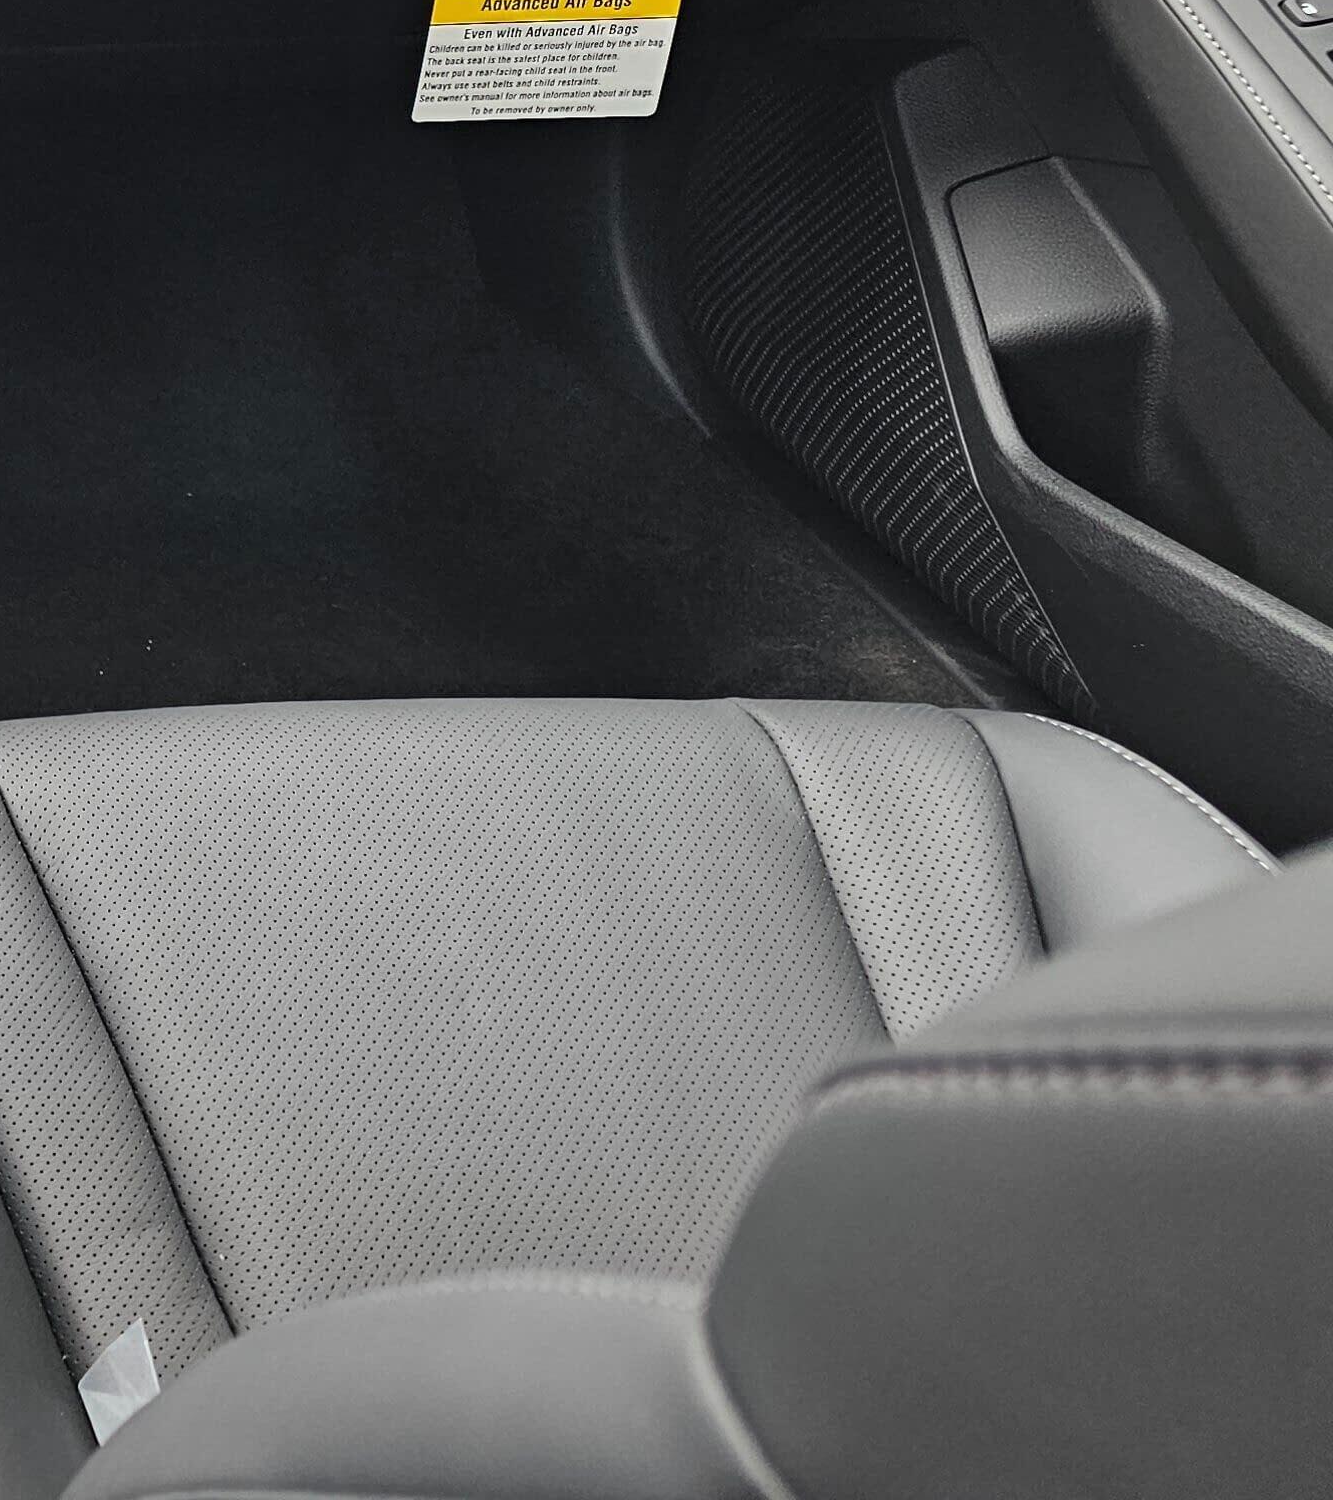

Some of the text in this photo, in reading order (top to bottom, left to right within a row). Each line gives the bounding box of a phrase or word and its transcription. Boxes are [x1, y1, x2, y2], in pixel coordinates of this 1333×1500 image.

[464, 24, 639, 40] Even with Advanced Air Bags
[429, 45, 465, 54] Children
[484, 44, 495, 52] be
[497, 43, 521, 51] killed
[534, 41, 572, 50] seriously
[574, 40, 604, 50] injured
[606, 40, 617, 49] by
[619, 39, 632, 47] the
[634, 39, 646, 47] air
[648, 39, 665, 48] bag.
[428, 58, 442, 66] The
[445, 57, 464, 65] back
[467, 56, 486, 64] seat
[514, 54, 540, 62] safest
[542, 54, 565, 63] place
[568, 53, 580, 61] for
[582, 52, 620, 61] children.
[424, 70, 450, 78] Never
[452, 69, 465, 79] put
[475, 68, 522, 76] rear-facing
[524, 67, 546, 75] child
[548, 66, 566, 74] seat
[579, 65, 593, 73] the
[595, 65, 617, 73] front.
[422, 83, 451, 91] Always
[471, 81, 490, 89] seat
[492, 80, 513, 88] belts
[557, 78, 600, 86] restraints.
[419, 88, 653, 103] See owner's manual for more information about air bags.
[471, 107, 480, 115] To
[495, 106, 533, 114] removed
[535, 105, 546, 114] by
[547, 105, 574, 113] owner
[576, 104, 596, 113] only.
